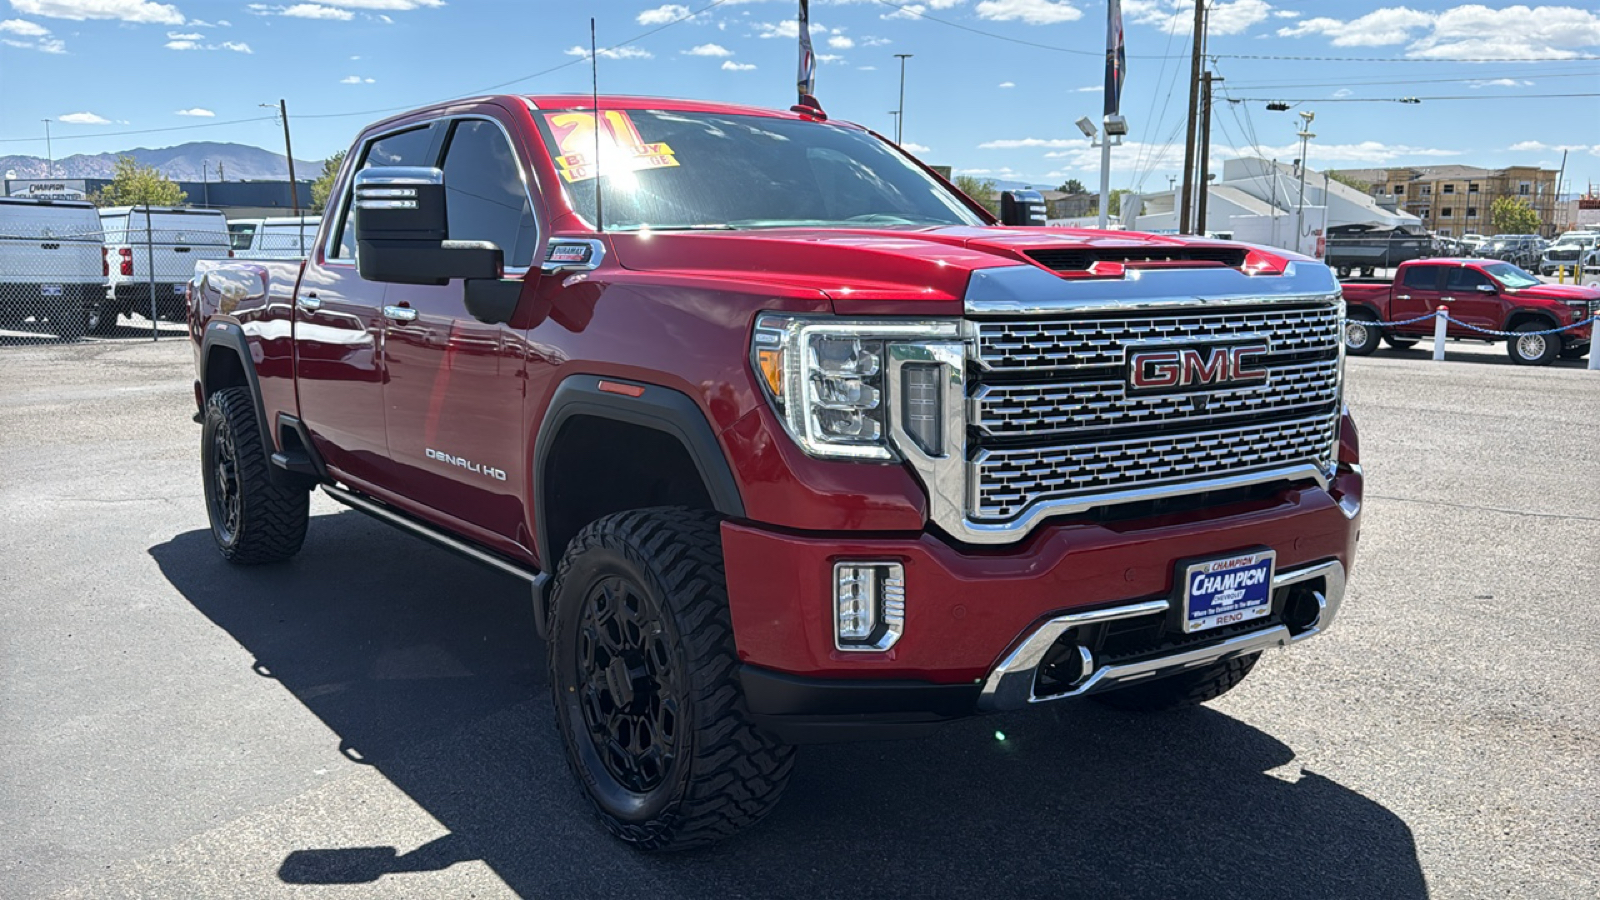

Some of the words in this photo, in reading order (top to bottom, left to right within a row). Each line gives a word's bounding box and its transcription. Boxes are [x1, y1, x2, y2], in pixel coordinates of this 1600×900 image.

[551, 110, 643, 154] 21
[29, 183, 65, 194] CHAMPION
[1130, 344, 1267, 389] GMC
[425, 448, 480, 473] DENALI
[483, 465, 507, 481] HD
[1212, 556, 1254, 571] CHAMPION
[1191, 567, 1267, 596] CHAMPION
[1214, 590, 1244, 601] CHEVROLET
[1216, 612, 1243, 625] RENO
